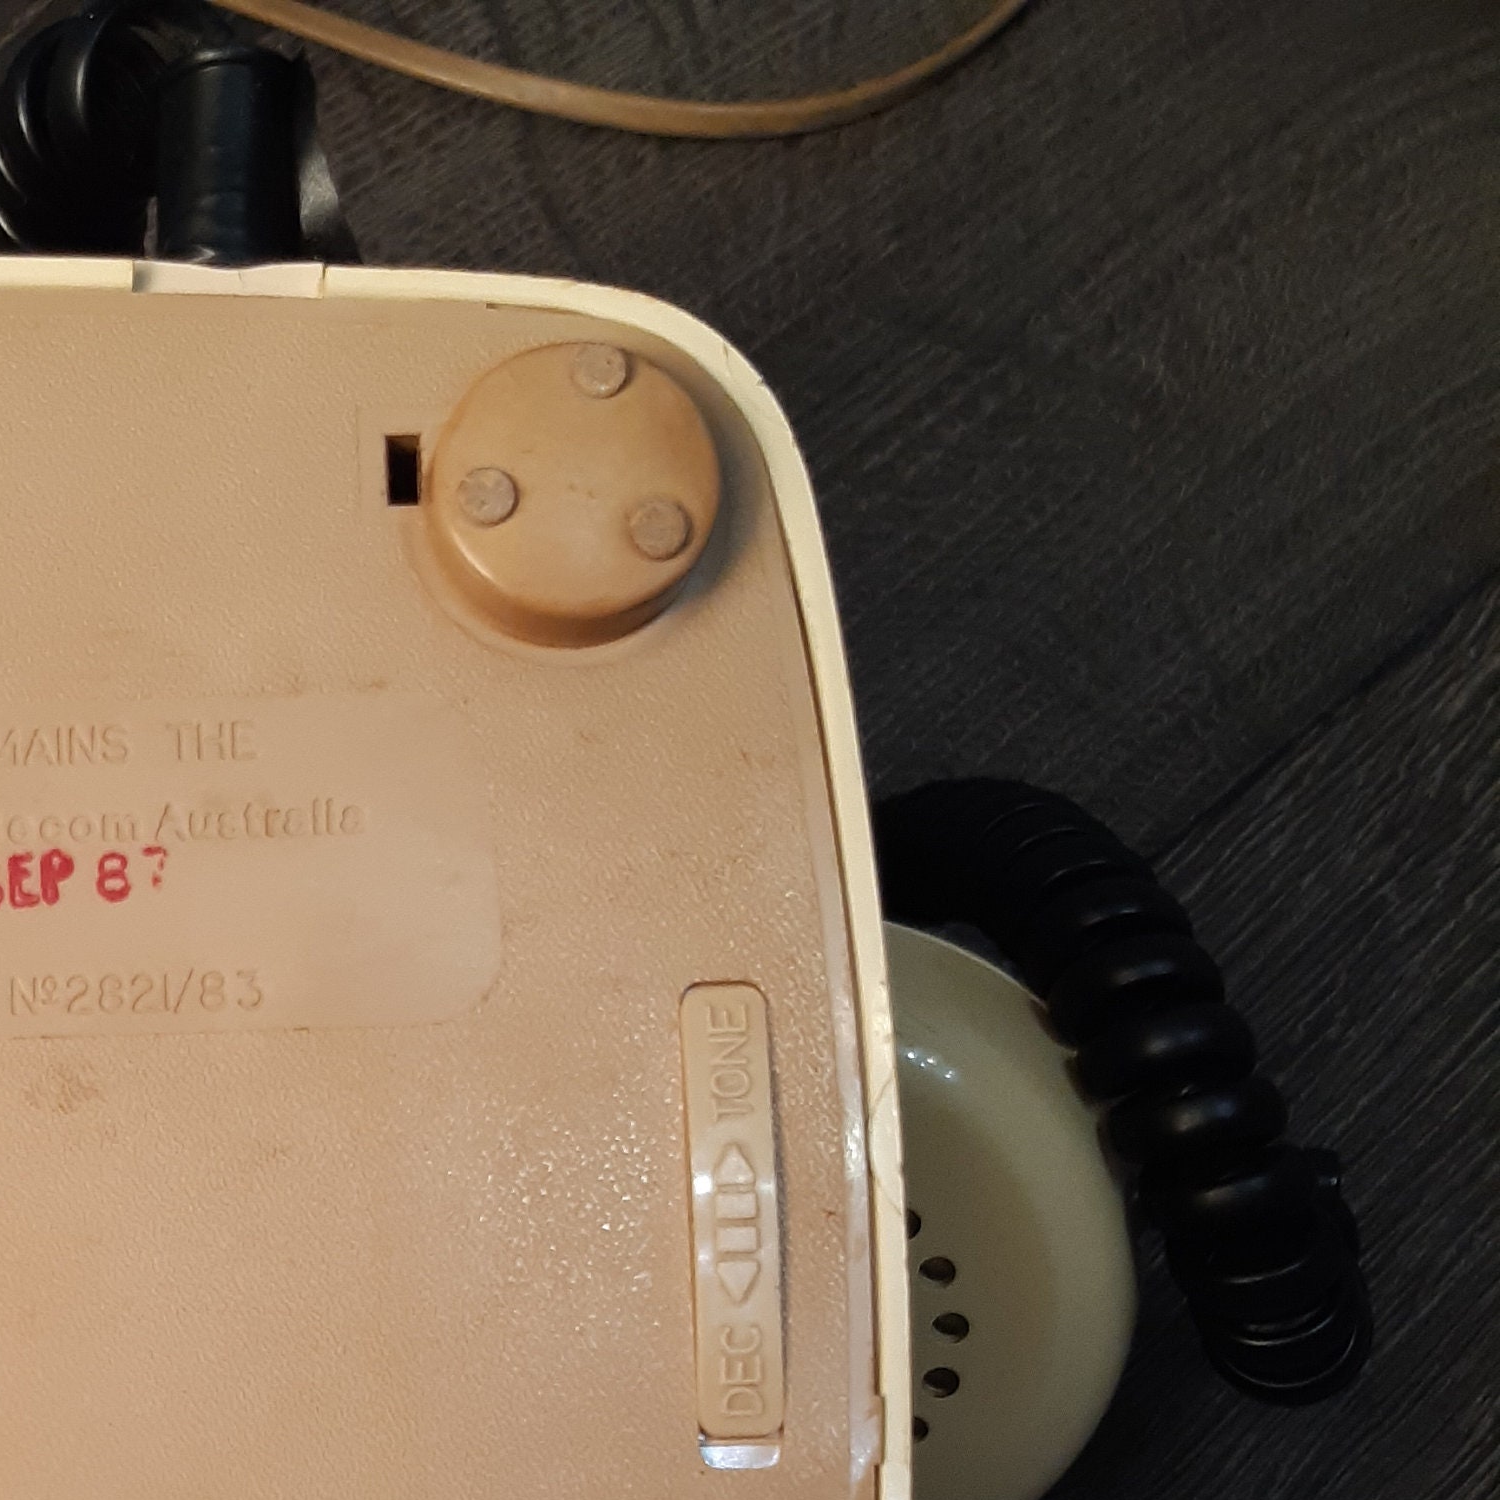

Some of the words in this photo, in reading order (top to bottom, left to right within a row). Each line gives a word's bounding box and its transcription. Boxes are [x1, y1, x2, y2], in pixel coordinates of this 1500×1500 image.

[164, 718, 257, 763] THE
[705, 1002, 754, 1121] TONE
[719, 1325, 766, 1418] DEC
